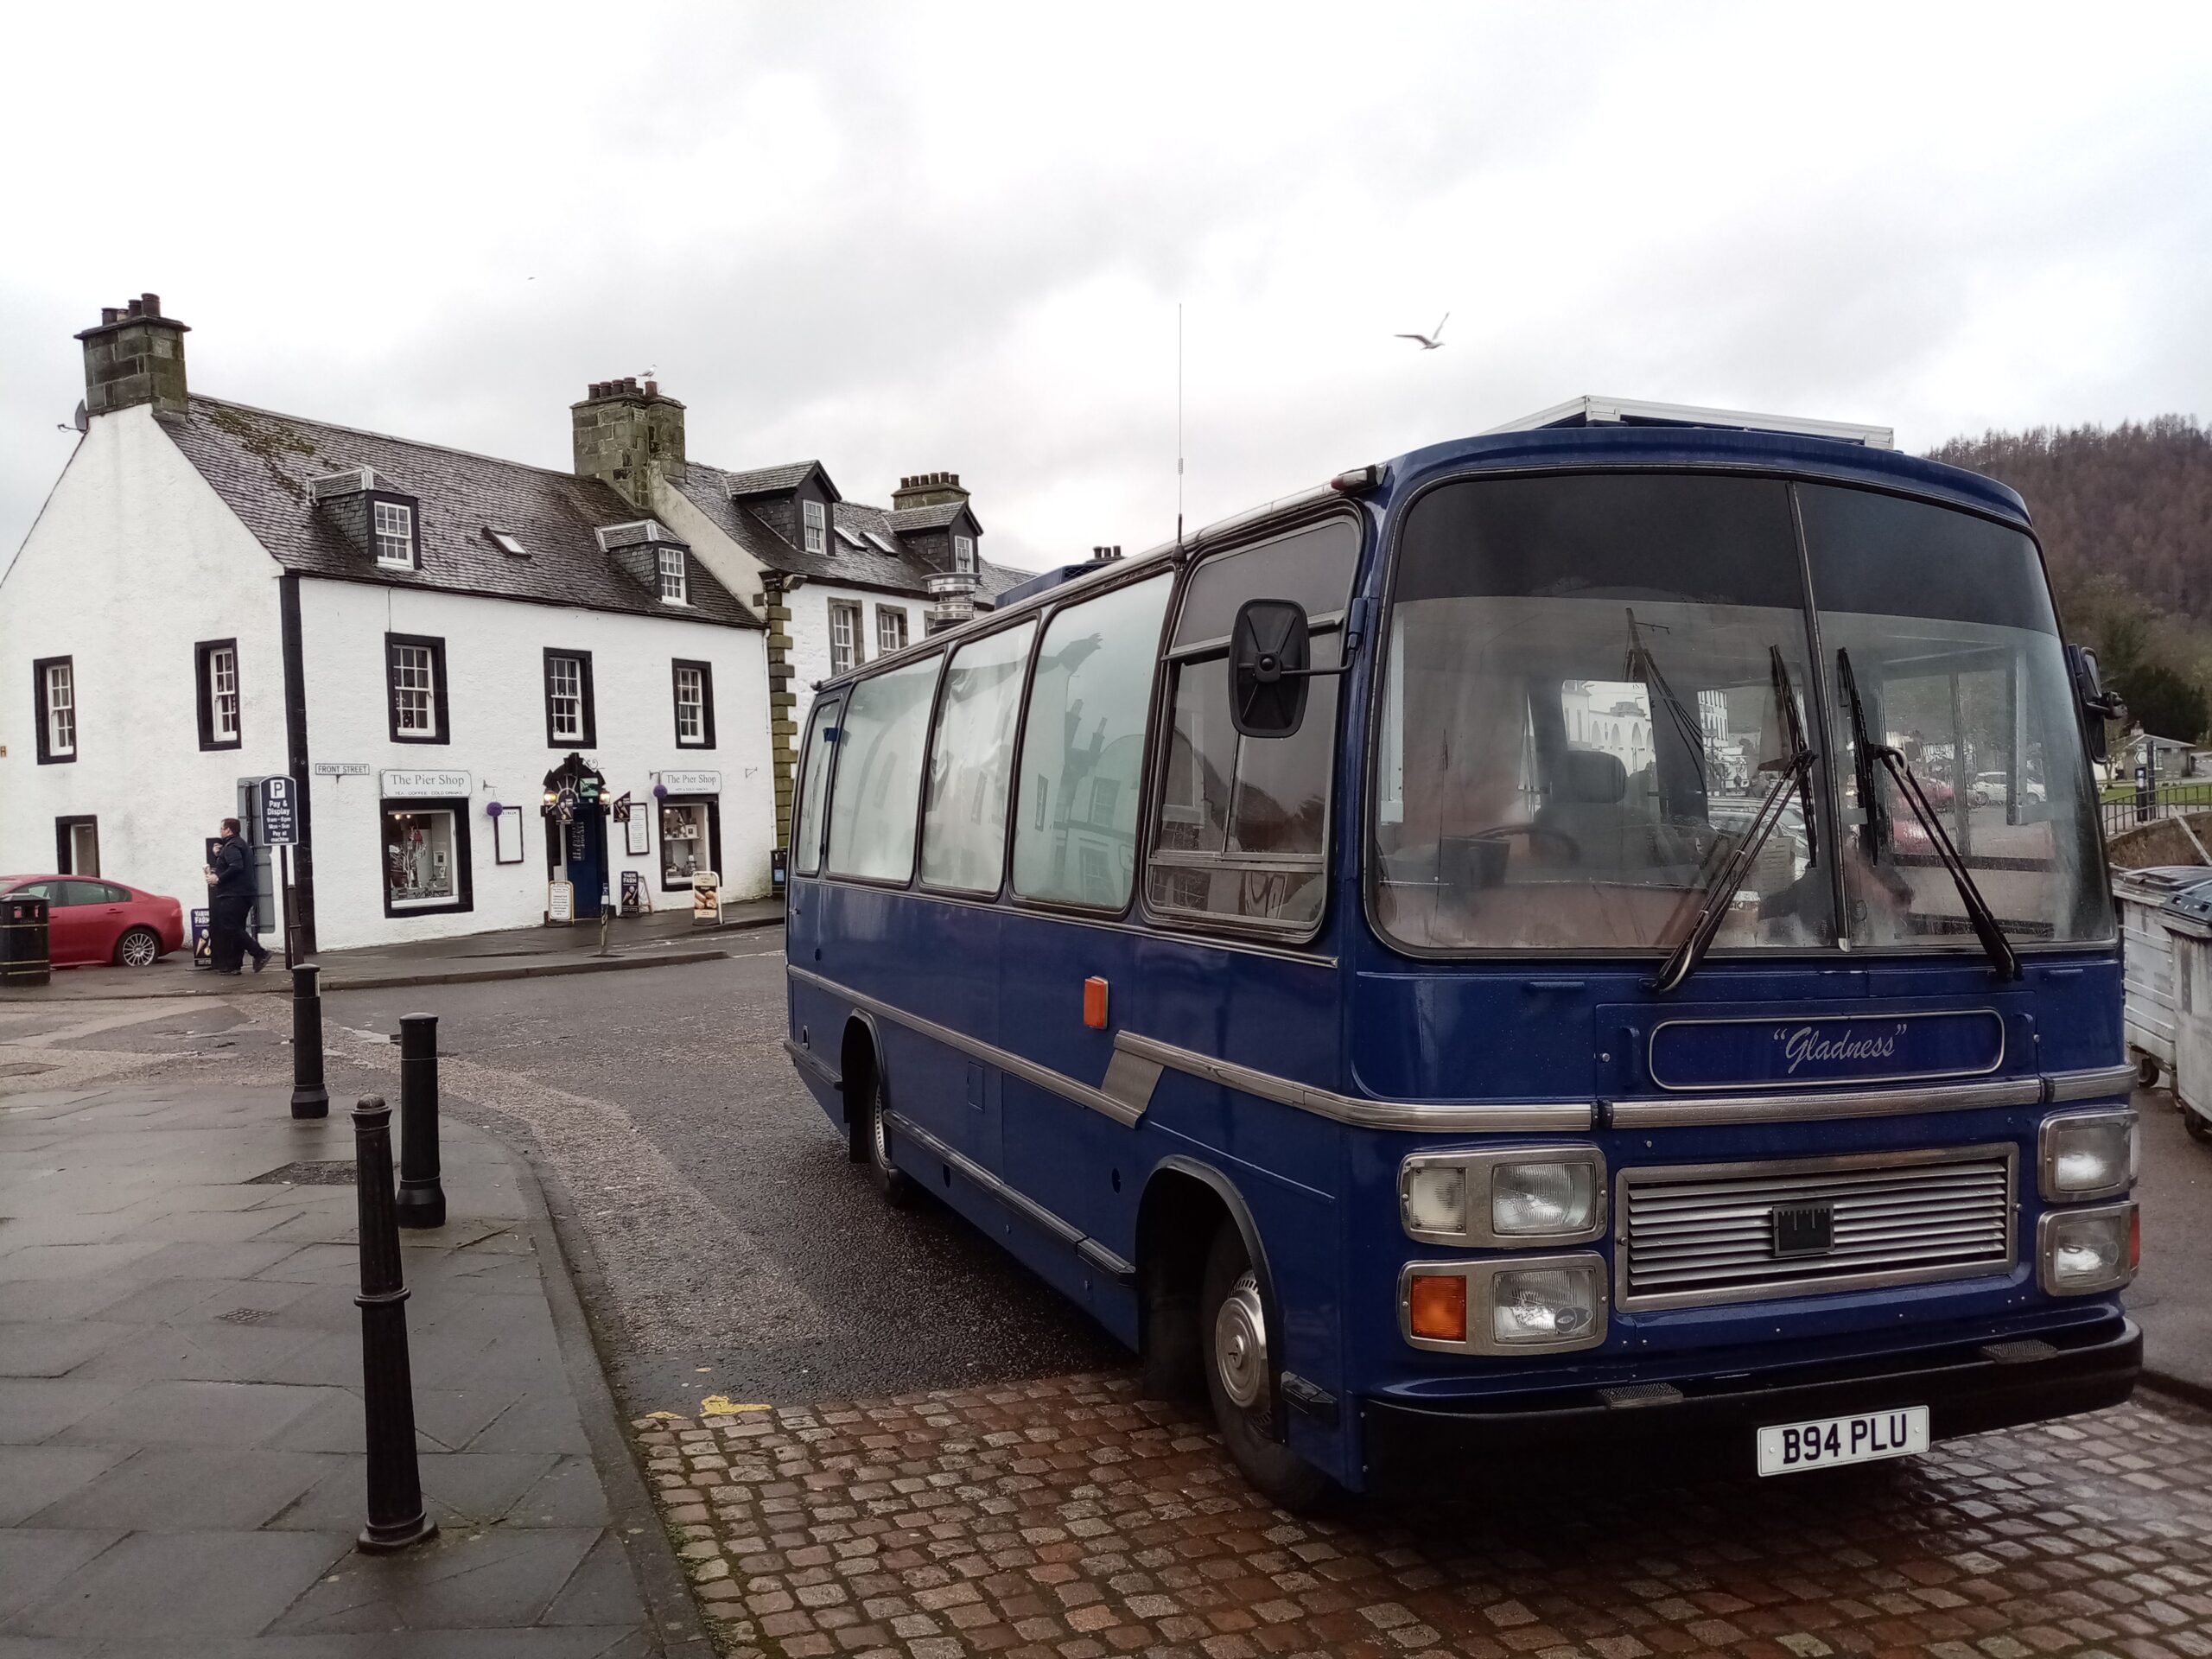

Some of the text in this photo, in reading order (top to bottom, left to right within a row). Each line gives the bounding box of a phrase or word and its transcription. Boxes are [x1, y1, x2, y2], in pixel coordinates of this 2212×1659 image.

[391, 774, 465, 787] The Pier Shop
[667, 774, 716, 785] The Pier Shop
[274, 782, 283, 797] P
[269, 800, 281, 809] Pay
[267, 807, 290, 817] Display
[1783, 1414, 1907, 1465] B94 PLU
